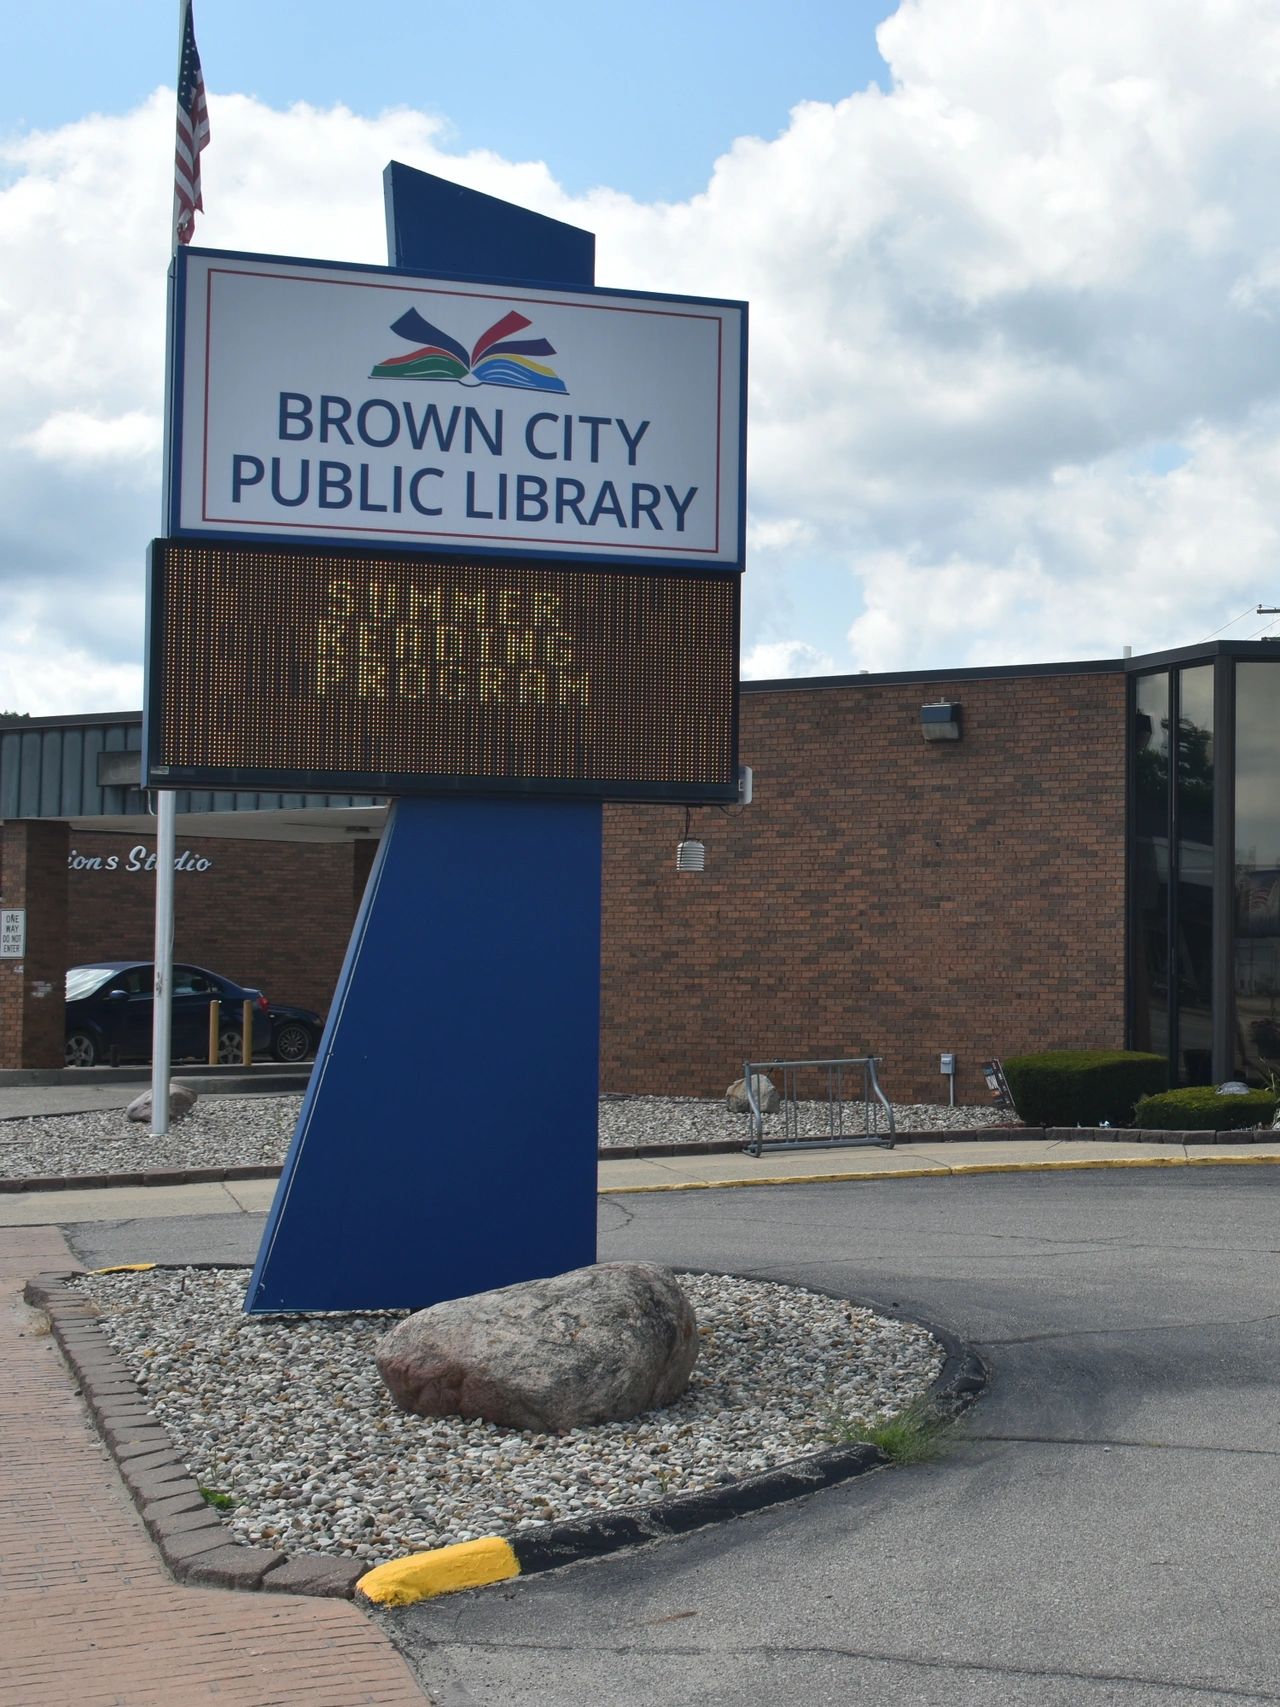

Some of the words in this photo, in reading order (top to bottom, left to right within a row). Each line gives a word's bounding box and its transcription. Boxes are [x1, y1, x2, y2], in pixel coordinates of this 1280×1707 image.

[277, 391, 503, 457] BROWN
[524, 411, 651, 467] CITY
[231, 453, 445, 517] PUBLIC
[465, 470, 699, 532] LIBRARY
[328, 580, 561, 627] SUMMER
[317, 618, 575, 666] READING
[316, 659, 590, 706] PROGRAM
[125, 845, 213, 872] Stdio
[6, 914, 20, 924] ONE
[6, 924, 20, 933] WAY
[2, 934, 11, 943] DO
[11, 934, 22, 943] NOT
[3, 944, 20, 953] ENTER
